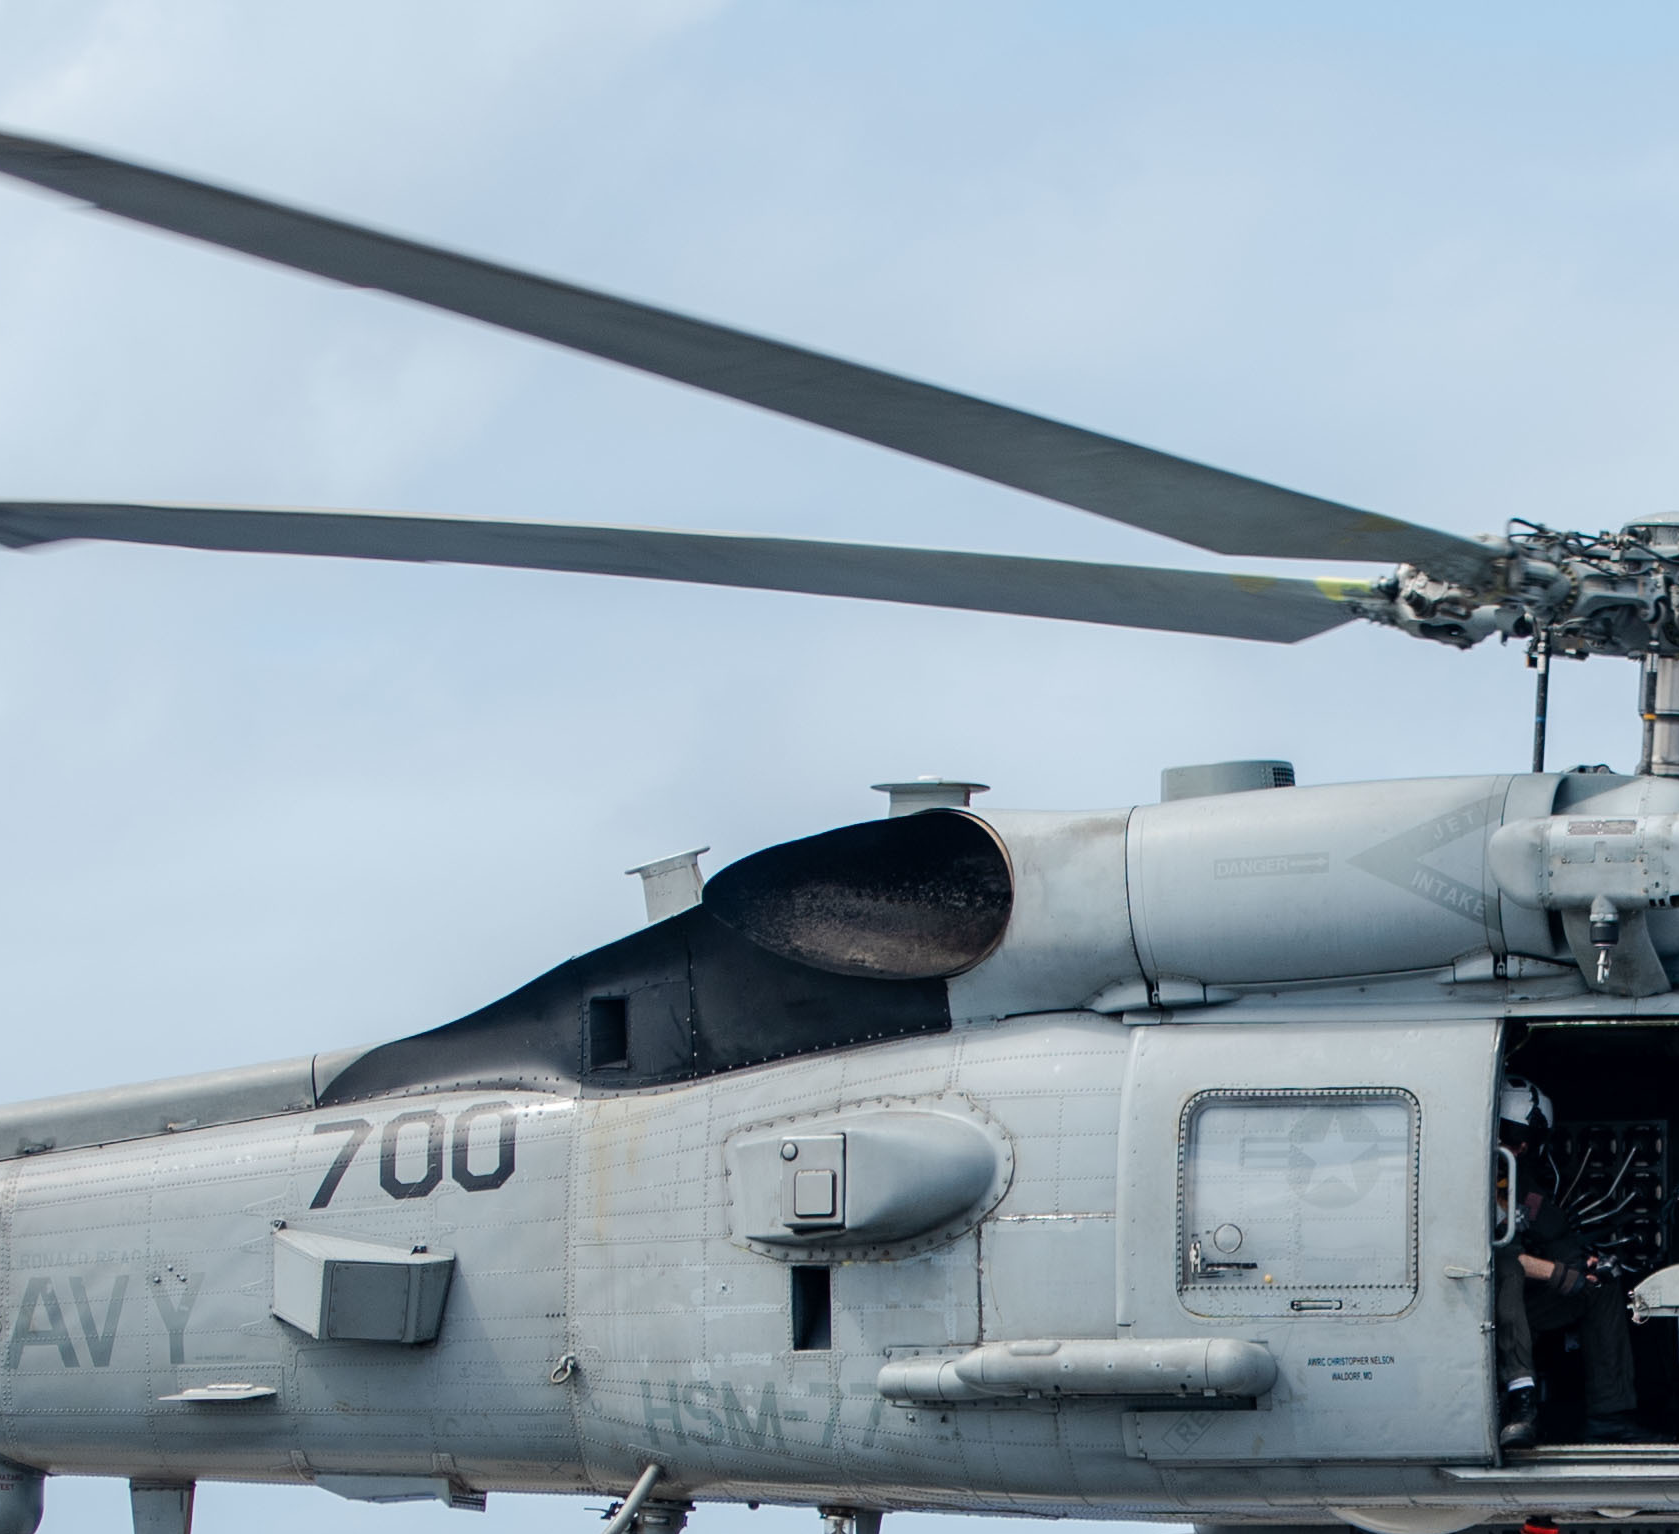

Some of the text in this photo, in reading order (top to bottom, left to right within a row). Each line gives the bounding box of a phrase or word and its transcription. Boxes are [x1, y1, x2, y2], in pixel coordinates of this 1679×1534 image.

[1433, 810, 1480, 841] JET
[1216, 857, 1289, 877] DANGER
[1410, 870, 1488, 919] INTAKE
[309, 1100, 518, 1210] 700
[1326, 1356, 1369, 1366] CHRISTOPHER
[1369, 1355, 1395, 1365] NELSON
[639, 1379, 885, 1450] HSM-77
